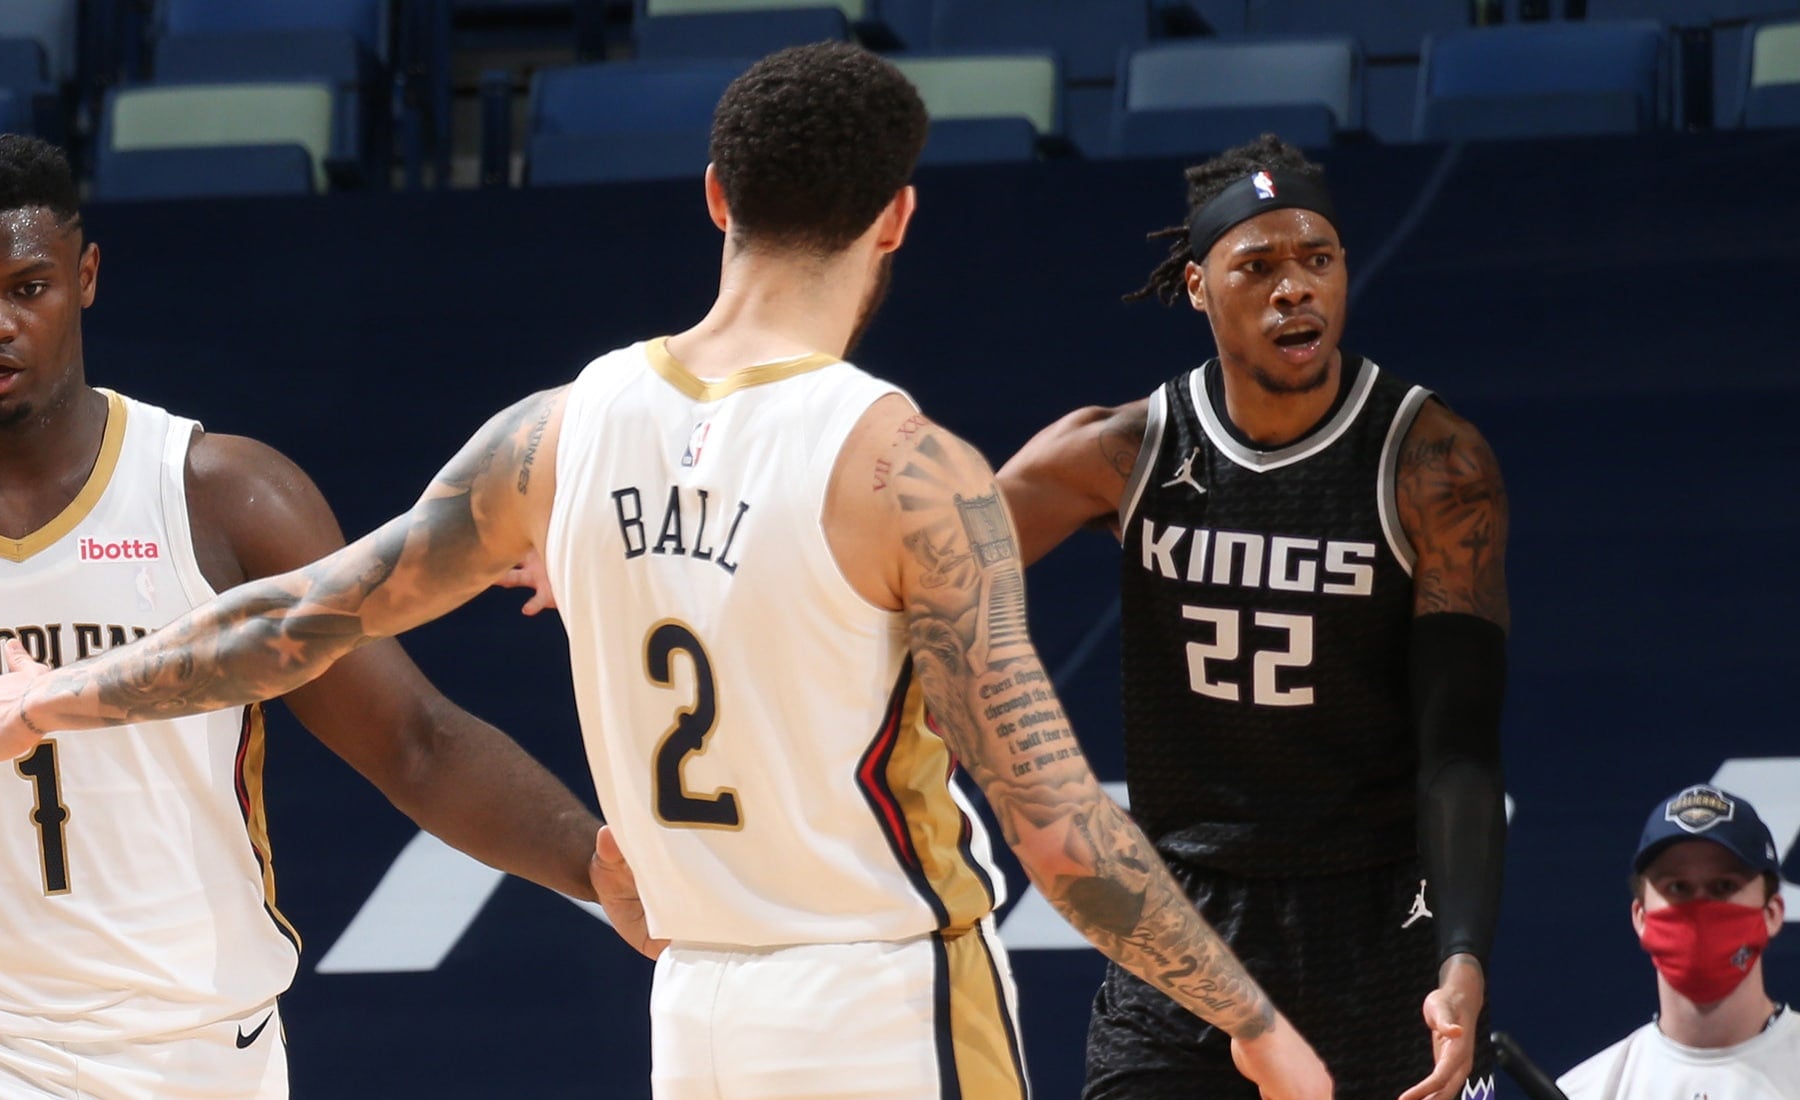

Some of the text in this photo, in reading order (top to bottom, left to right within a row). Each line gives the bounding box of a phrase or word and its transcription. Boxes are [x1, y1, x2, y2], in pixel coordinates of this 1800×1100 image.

[518, 404, 552, 495] ONTINUES
[80, 538, 159, 560] ibotta
[611, 485, 750, 576] BALL
[1141, 519, 1376, 597] KINGS
[1181, 604, 1315, 707] 22
[642, 617, 745, 830] 2
[15, 738, 72, 897] 1
[1157, 955, 1198, 988] 2
